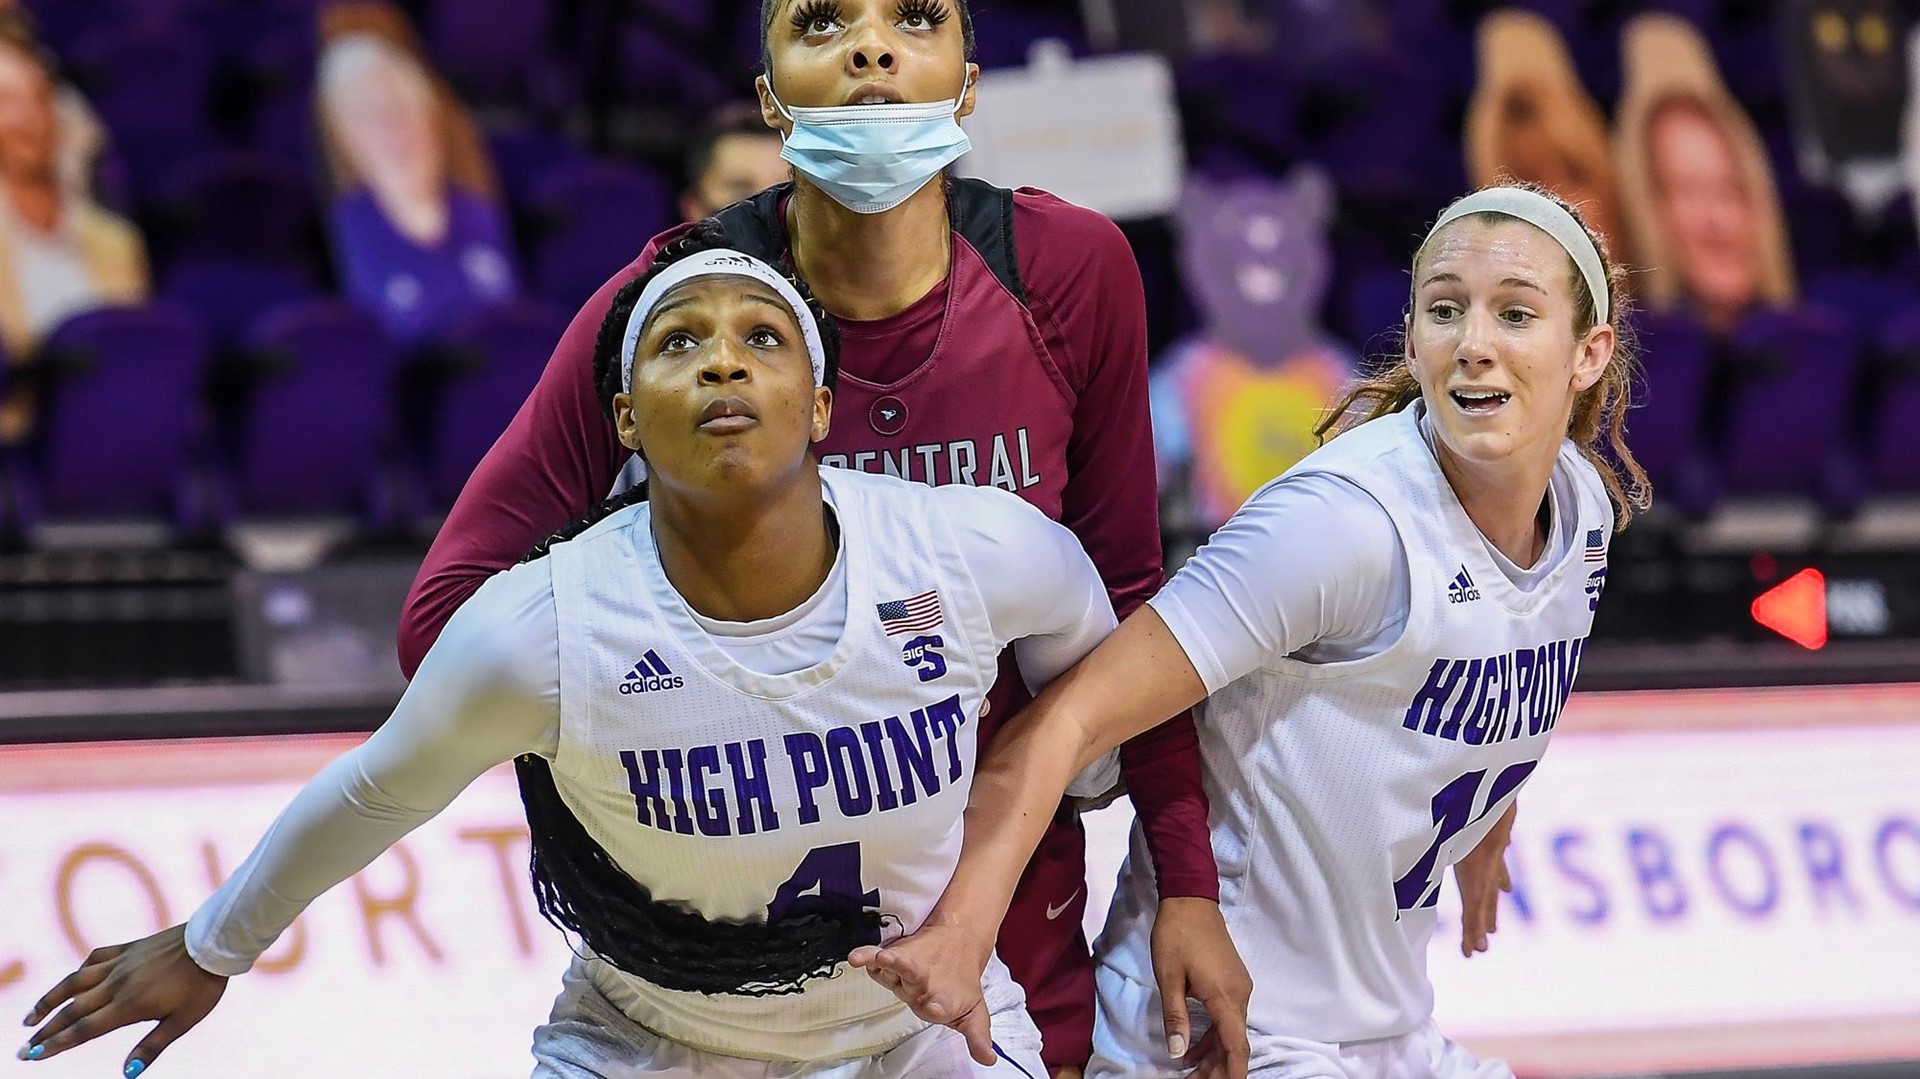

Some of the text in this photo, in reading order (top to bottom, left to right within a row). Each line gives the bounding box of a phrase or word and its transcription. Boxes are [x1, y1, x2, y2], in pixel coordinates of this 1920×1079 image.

[618, 675, 684, 695] adidas
[1402, 637, 1588, 746] HIGH POIN
[618, 693, 966, 837] HIGH POINT
[766, 840, 882, 947] 4
